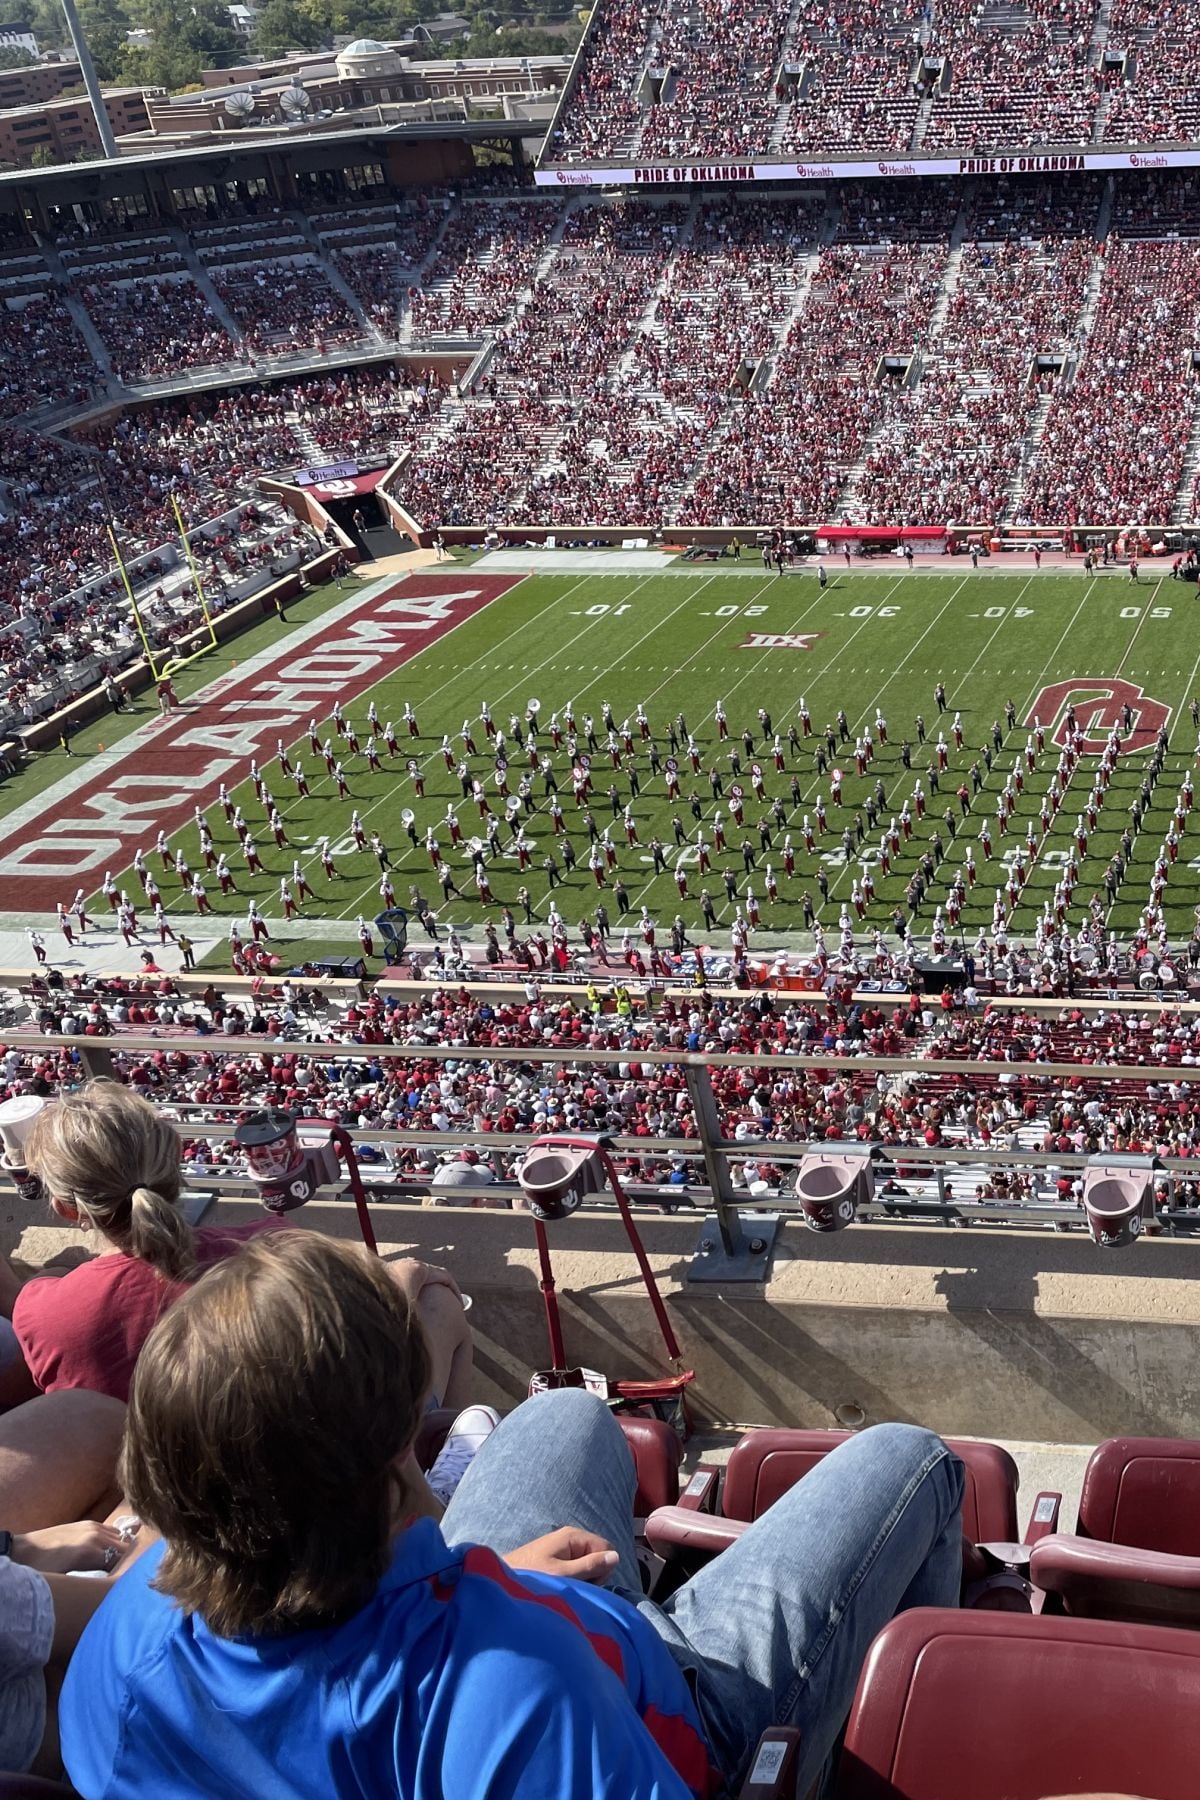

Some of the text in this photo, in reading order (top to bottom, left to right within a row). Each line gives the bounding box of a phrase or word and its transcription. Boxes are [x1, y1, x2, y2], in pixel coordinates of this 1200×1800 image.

[960, 156, 1086, 173] PRIDE OF OKLAHOMA
[1130, 154, 1168, 166] OU Health
[634, 166, 755, 182] PRIDE OF OKLAHOMA
[797, 164, 834, 177] OU Health
[878, 162, 916, 175] OU Health
[556, 172, 592, 184] OU Health
[320, 468, 347, 480] Health
[585, 604, 632, 616] 10
[714, 604, 771, 617] 20
[849, 604, 901, 617] 30
[982, 606, 1035, 618] 40
[1119, 606, 1173, 618] 50
[1022, 678, 1173, 756] OU
[0, 589, 484, 877] OKLAHOMA
[820, 846, 881, 867] 40
[804, 980, 815, 989] G
[290, 1180, 310, 1200] OU
[839, 1200, 854, 1220] OU
